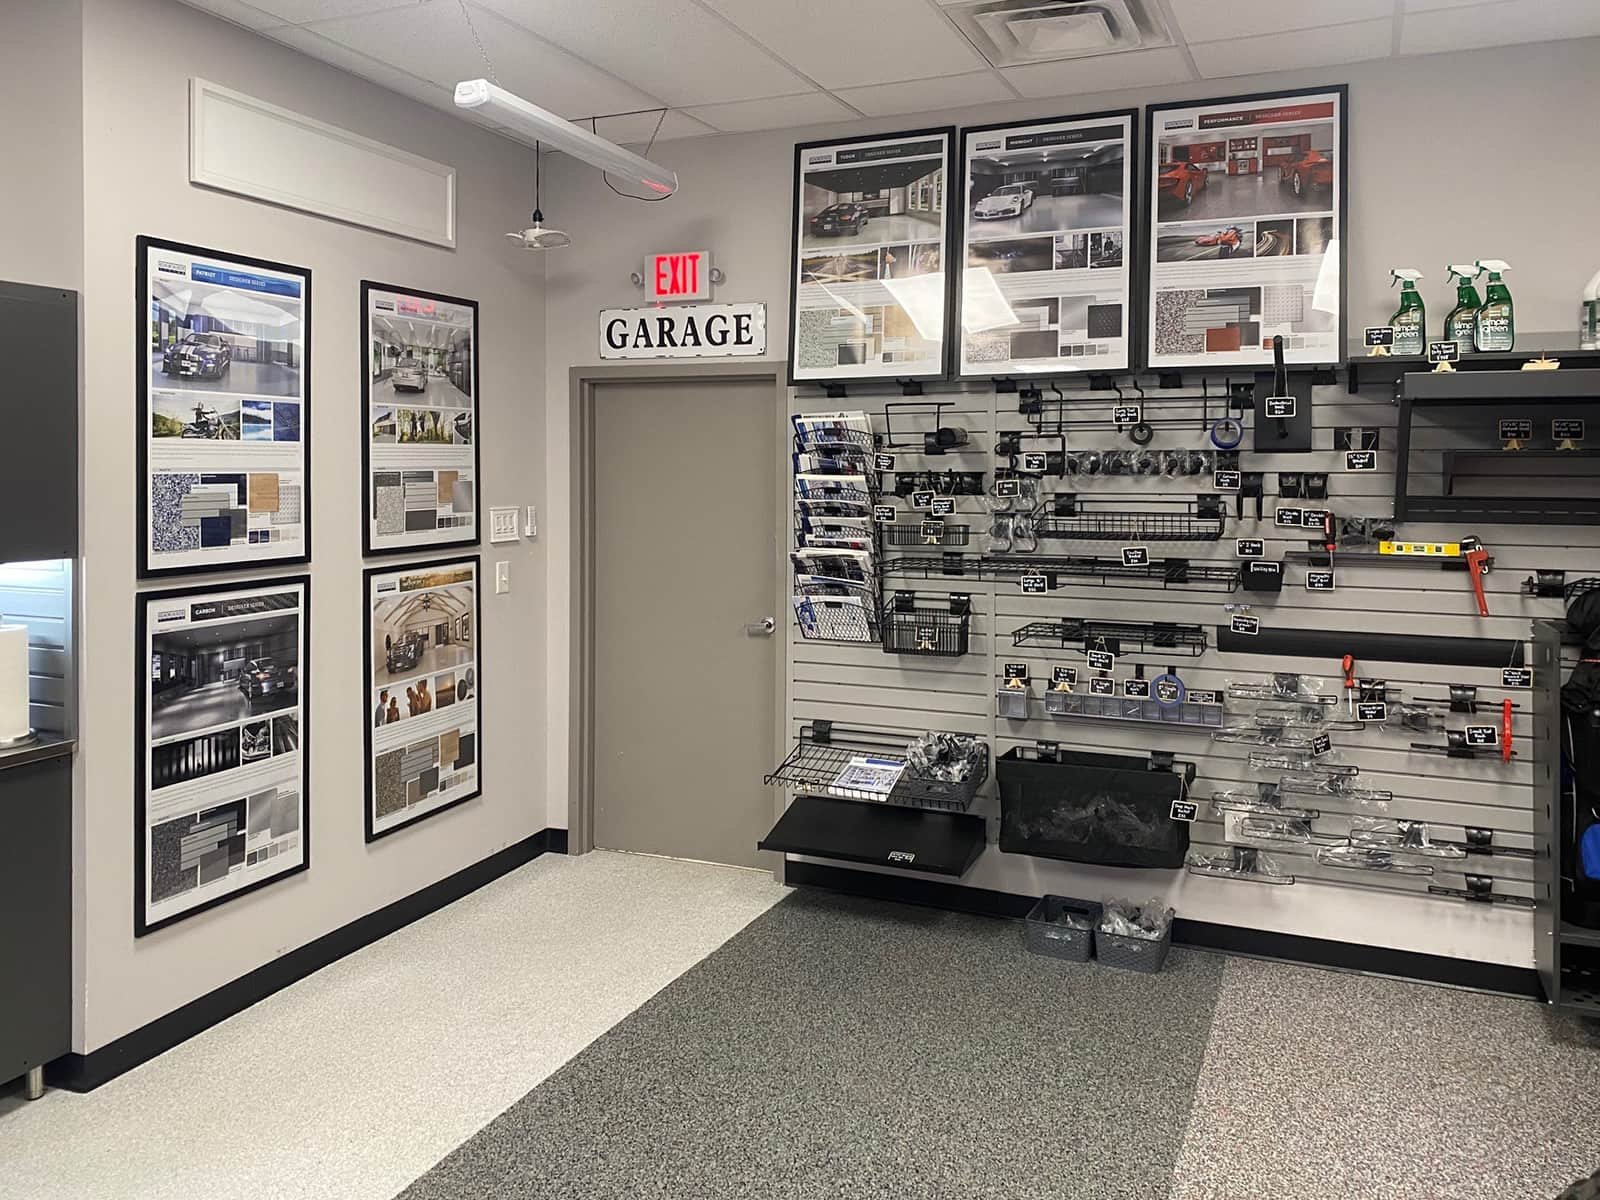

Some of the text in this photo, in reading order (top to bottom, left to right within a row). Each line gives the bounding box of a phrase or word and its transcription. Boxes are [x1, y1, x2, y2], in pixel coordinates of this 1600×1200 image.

[655, 254, 700, 296] EXIT
[606, 314, 753, 349] GARAGE
[1481, 326, 1508, 335] green
